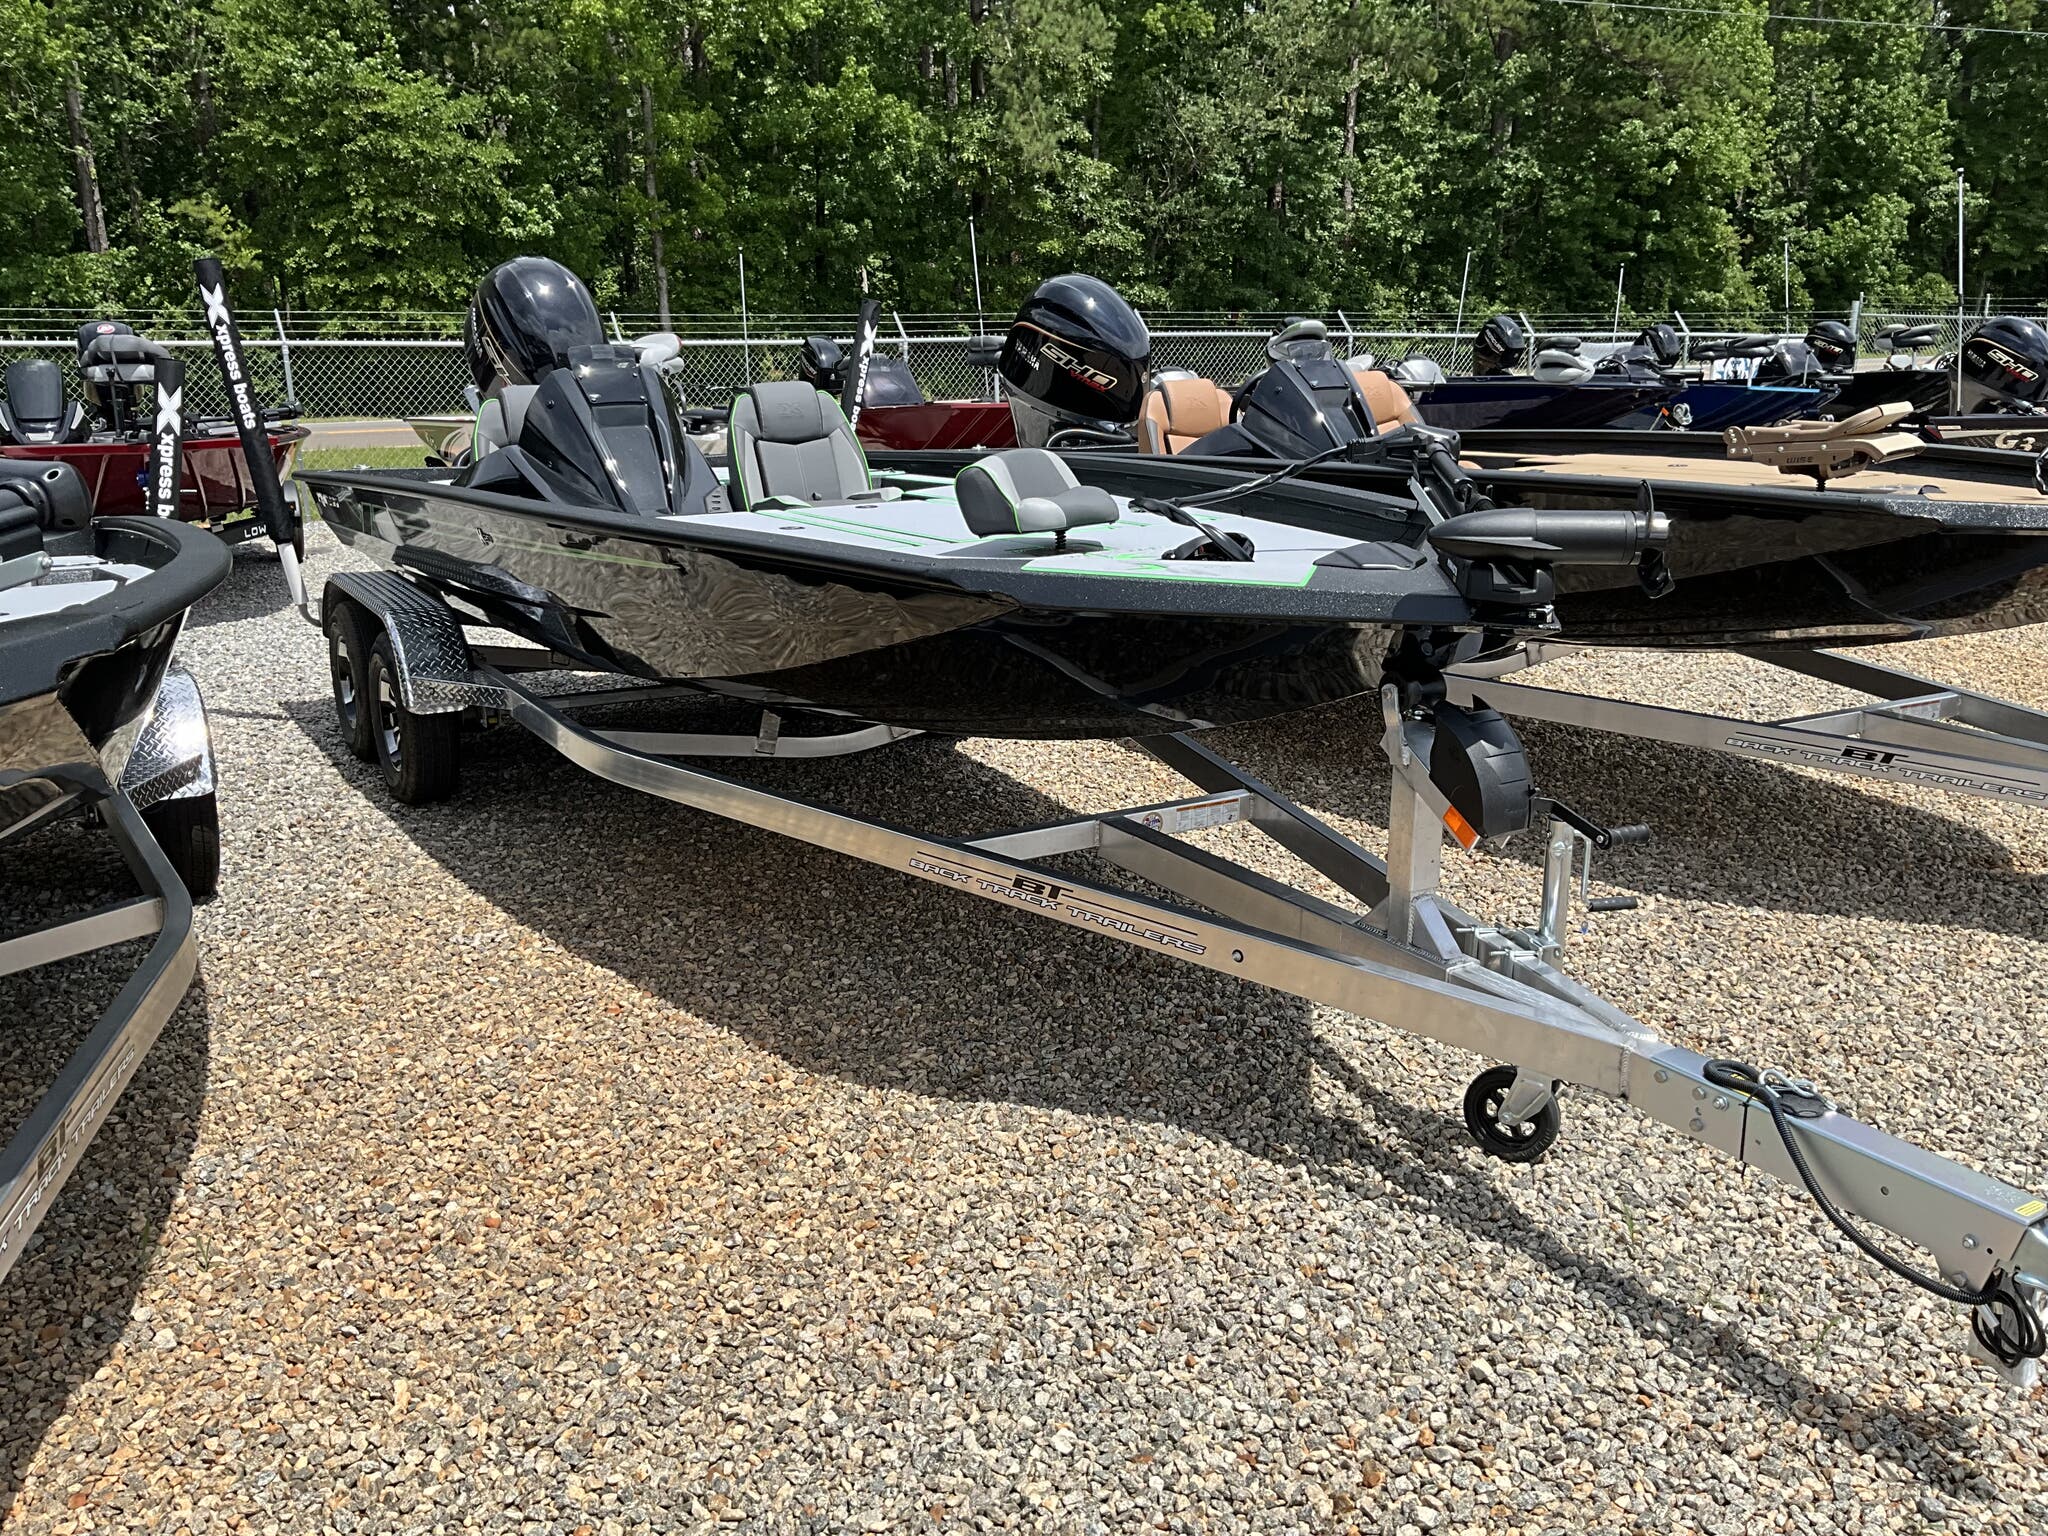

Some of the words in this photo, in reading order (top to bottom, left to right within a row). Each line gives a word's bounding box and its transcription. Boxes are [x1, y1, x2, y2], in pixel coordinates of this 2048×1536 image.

[215, 323, 242, 381] xpress
[233, 382, 257, 430] boats
[854, 355, 870, 403] xpress
[1040, 342, 1118, 390] SHO
[850, 405, 861, 431] boa
[1994, 431, 2036, 452] G3
[157, 432, 174, 500] xpress
[244, 524, 267, 538] LOW
[1725, 737, 1798, 757] BACK
[1800, 749, 1896, 774] TRACK
[1900, 767, 2047, 801] TRAILERS
[1840, 745, 1909, 764] BT
[908, 858, 973, 883] BACK
[975, 878, 1063, 911] TRACK
[1066, 904, 1207, 955] TRAILERS
[1011, 874, 1074, 900] BT
[14, 1140, 70, 1232] TRACK
[71, 1046, 136, 1145] TRAILERS
